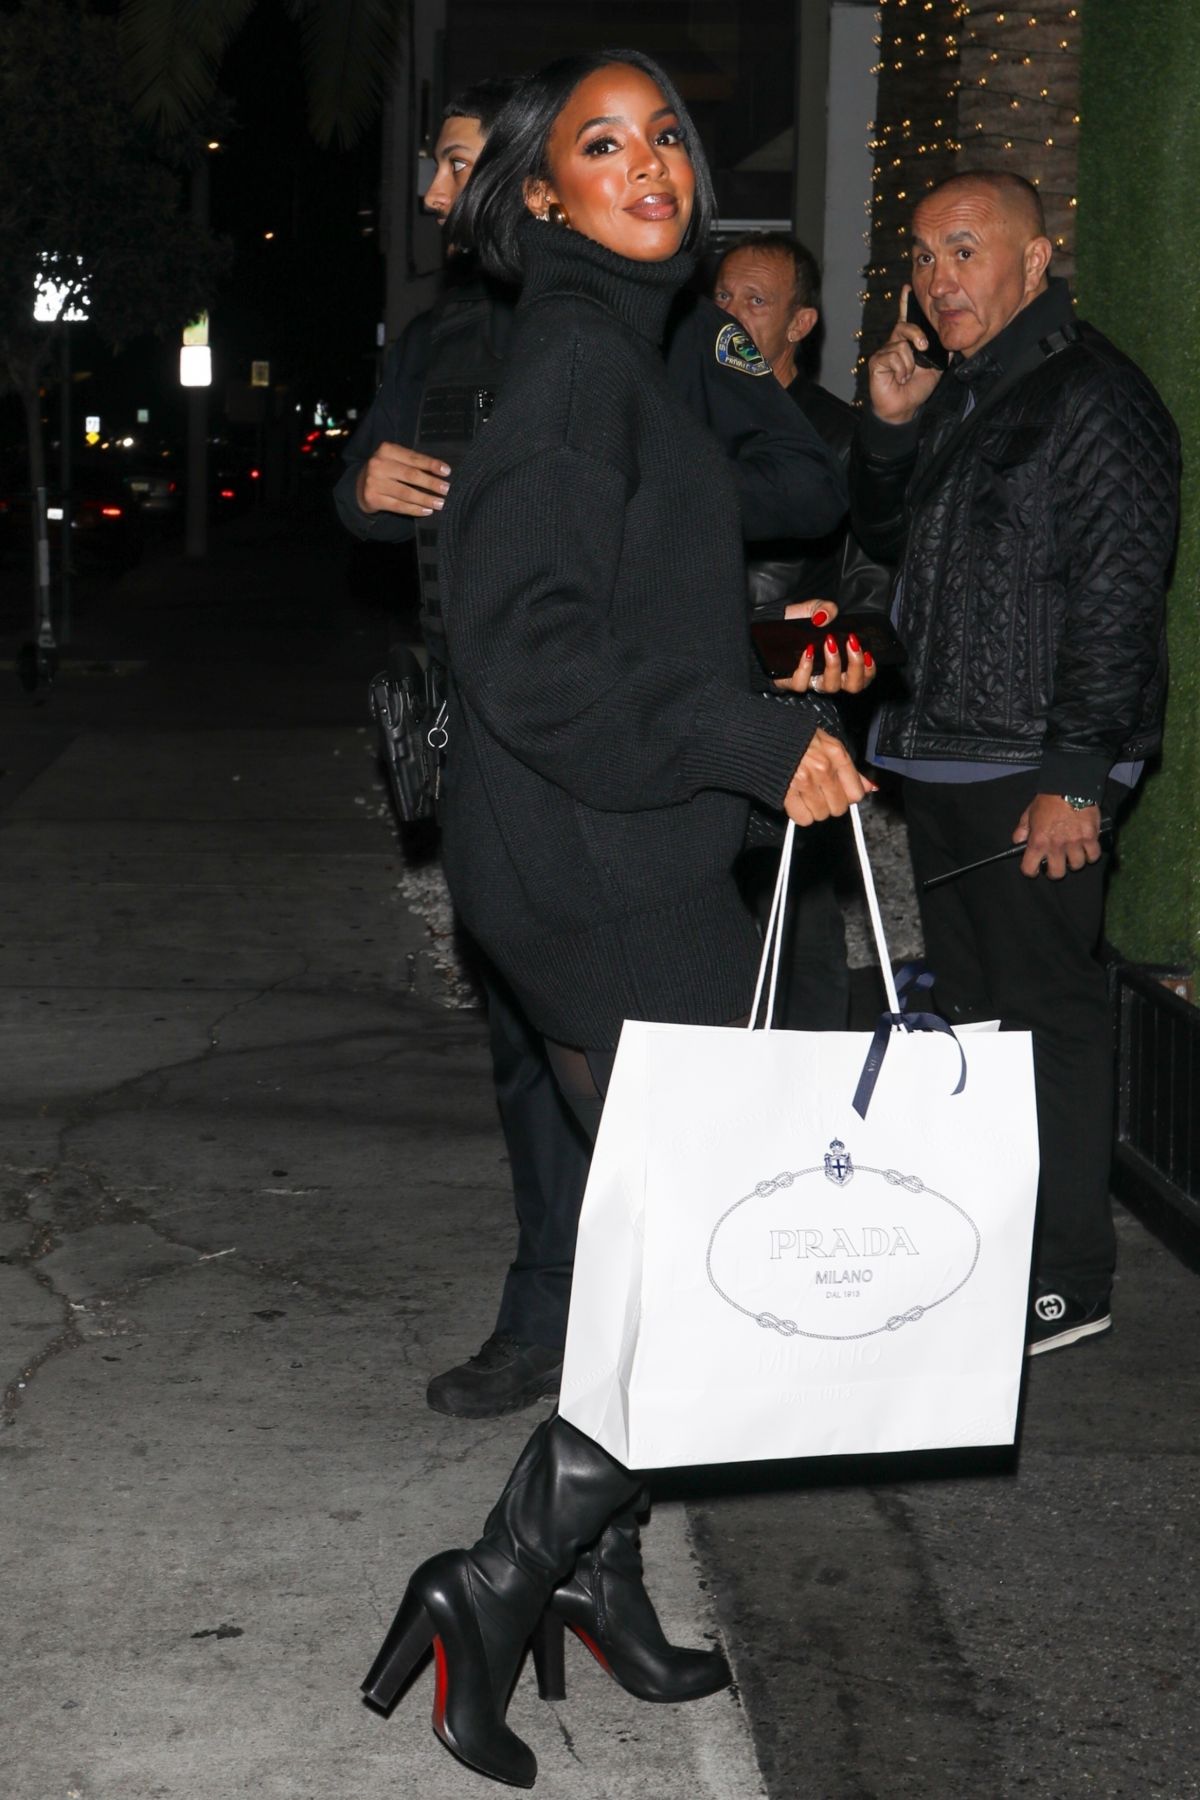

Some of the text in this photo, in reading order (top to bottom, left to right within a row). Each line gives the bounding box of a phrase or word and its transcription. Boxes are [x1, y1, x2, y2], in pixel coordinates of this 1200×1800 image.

[769, 1226, 920, 1260] PRADA
[815, 1269, 873, 1284] MILANO
[825, 1289, 860, 1299] DAL 1913
